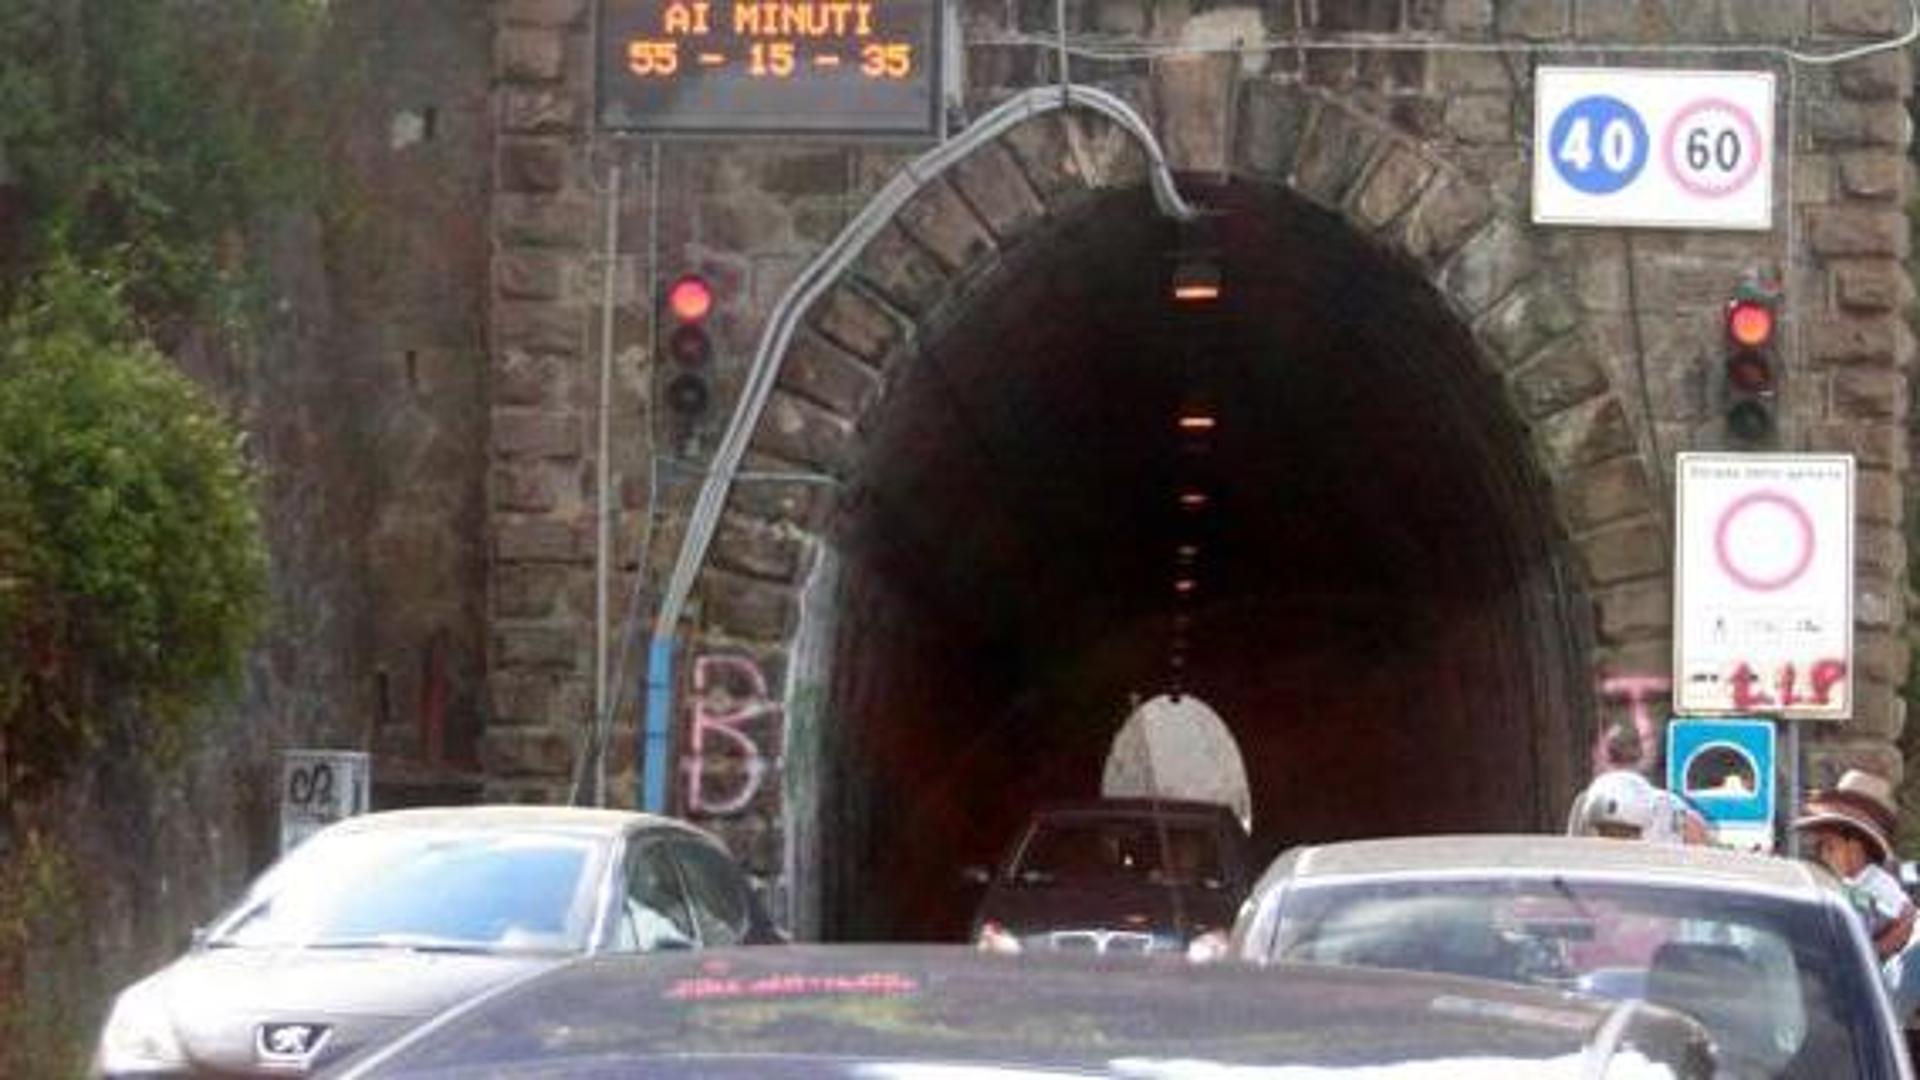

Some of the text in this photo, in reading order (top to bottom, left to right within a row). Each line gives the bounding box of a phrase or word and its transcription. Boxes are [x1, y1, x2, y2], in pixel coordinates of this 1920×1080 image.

[663, 2, 872, 34] AI MINUTI
[629, 42, 678, 76] 55
[751, 43, 795, 76] 15
[862, 44, 911, 77] 35
[1558, 116, 1635, 173] 40
[1687, 127, 1742, 172] 60
